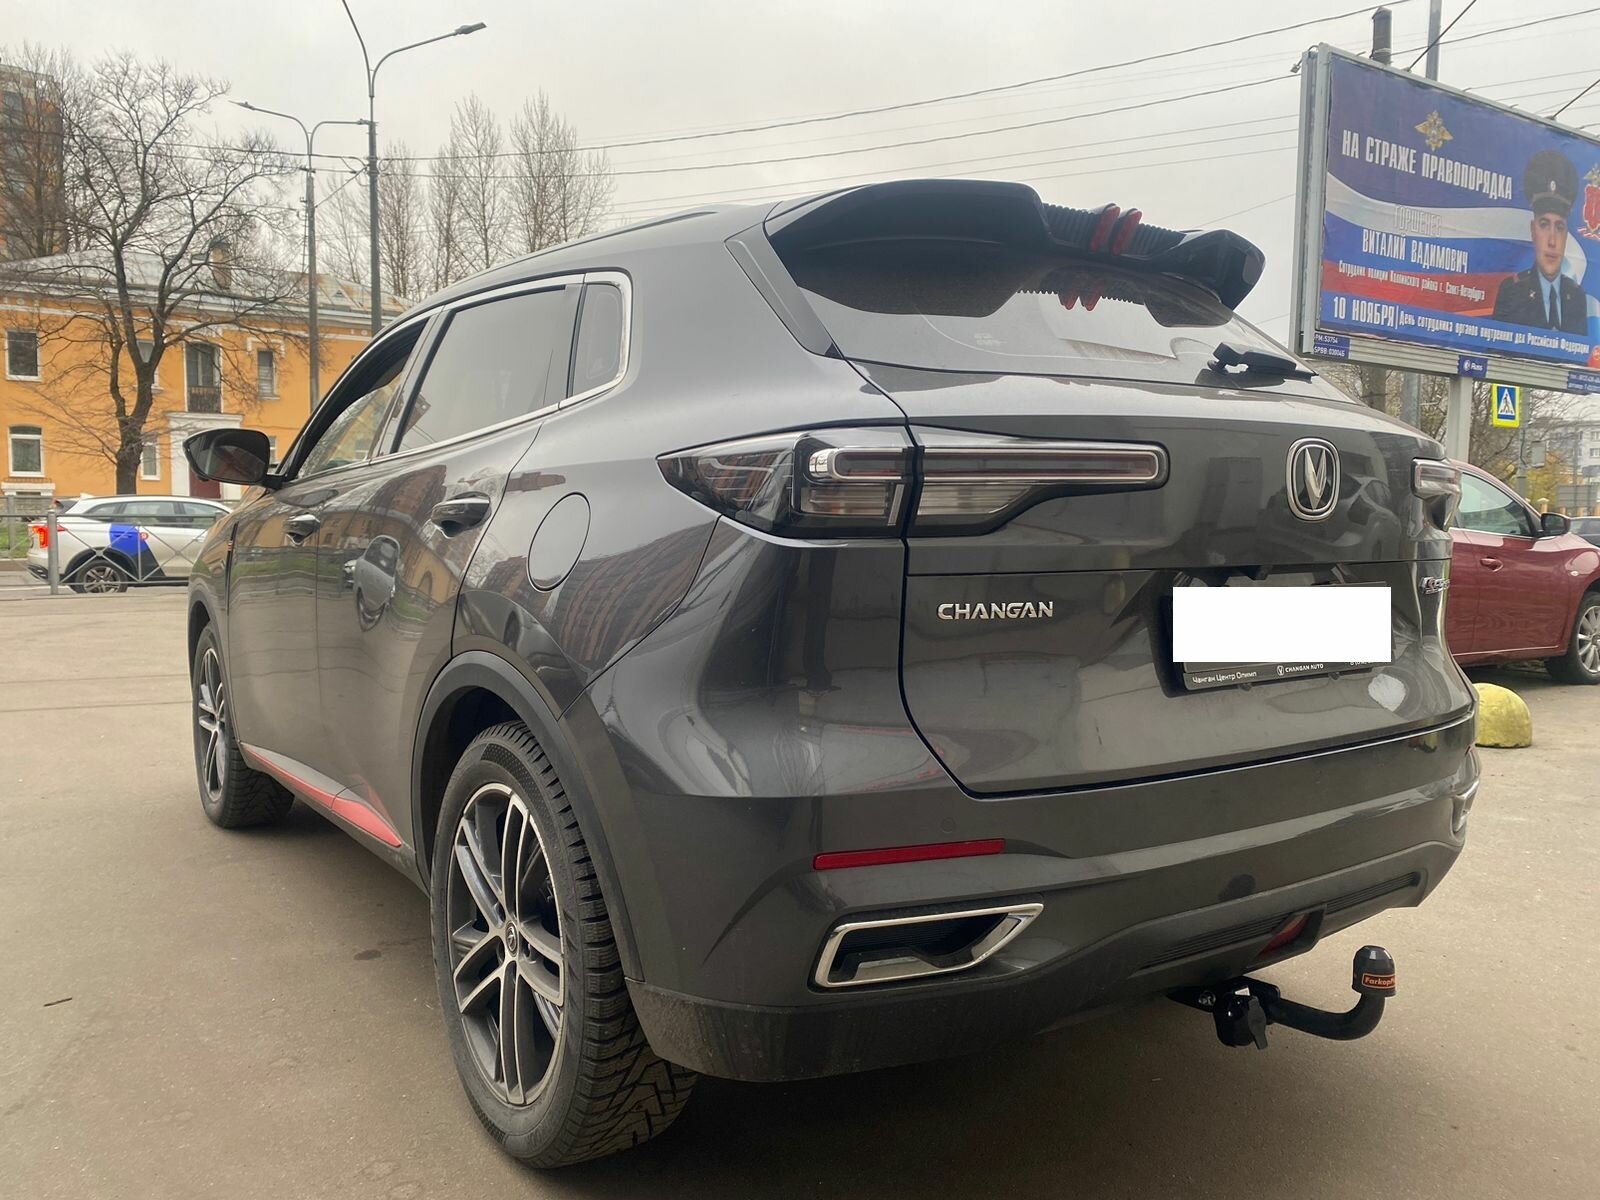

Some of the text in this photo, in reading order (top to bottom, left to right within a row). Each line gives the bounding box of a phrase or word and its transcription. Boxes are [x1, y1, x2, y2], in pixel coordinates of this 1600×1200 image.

[1342, 130, 1512, 200] НА СТРАЖЕ ПРАВОПОРЯДКА
[1362, 229, 1468, 273] ВИТАЛИЙ ВАДИМОВИЧ
[1339, 260, 1365, 277] Сотрудник
[1333, 297, 1346, 319] 10
[1352, 299, 1395, 328] НОЯБРЯ
[1399, 310, 1415, 326] День
[1417, 316, 1453, 333] сотрудника
[1514, 333, 1525, 344] дел
[1527, 332, 1559, 349] Российской
[1560, 338, 1590, 354] Федерации
[938, 601, 1053, 620] CHANGAN
[1192, 675, 1215, 684] Чанган
[1216, 672, 1235, 683] Центр
[1285, 665, 1310, 673] CHANGAN
